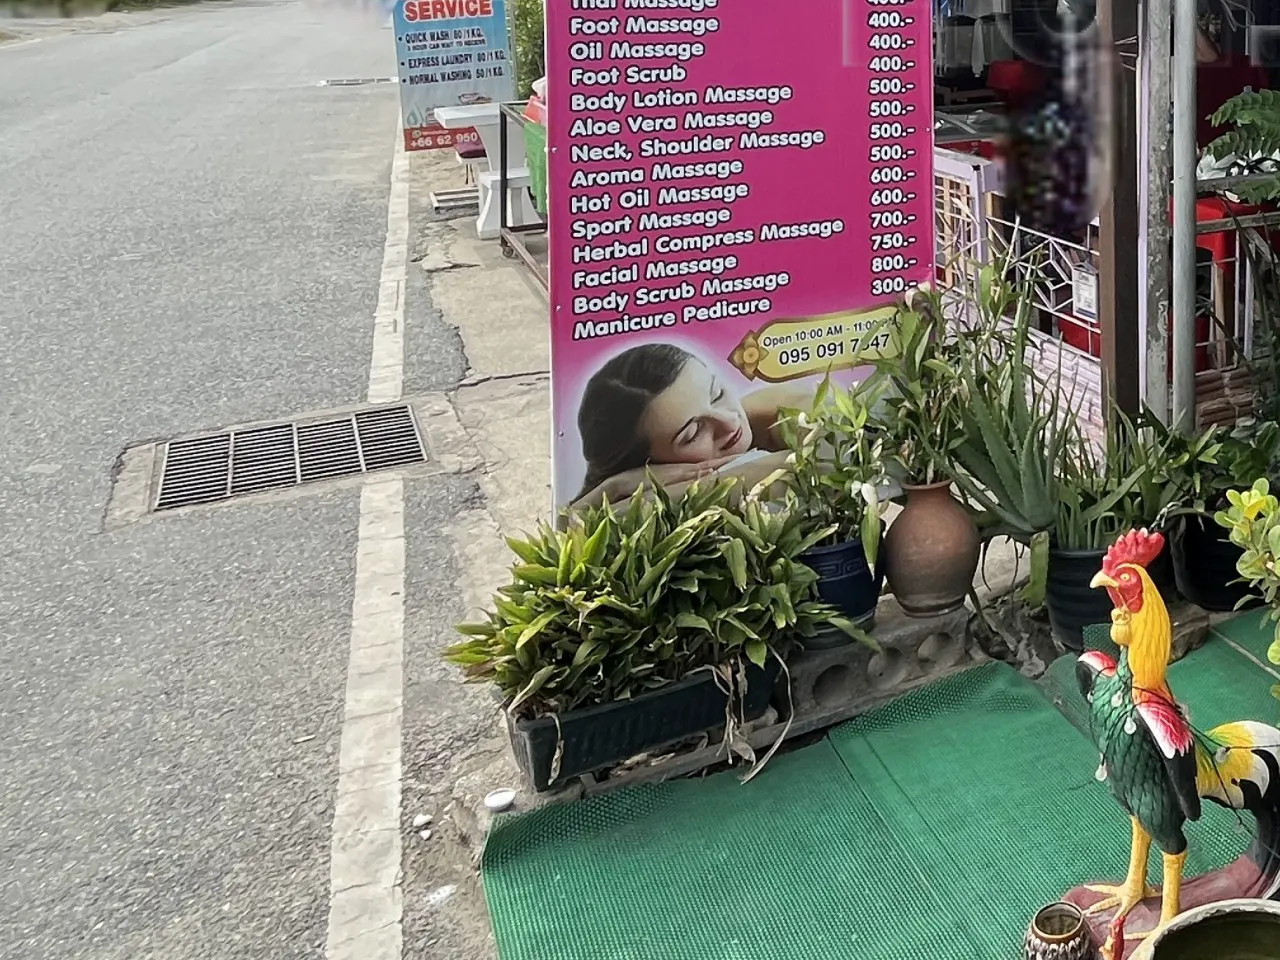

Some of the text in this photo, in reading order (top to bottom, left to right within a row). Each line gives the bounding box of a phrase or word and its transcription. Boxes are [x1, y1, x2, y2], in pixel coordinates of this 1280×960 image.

[404, 0, 493, 21] SERVICE
[571, 12, 913, 36] Foot Massage 400.-
[405, 31, 427, 44] QUICK
[430, 29, 450, 42] WASH
[570, 34, 914, 60] Oil Massage 400.-
[409, 56, 439, 69] EXPRESS
[442, 53, 472, 65] LAUNDRY
[409, 72, 439, 85] NORMAL
[441, 69, 472, 82] WASHING
[571, 56, 914, 86] Foot Scrub 400.-
[571, 78, 914, 113] Body Lotion Massage 500.-
[570, 100, 914, 136] Aloe Vera Massage 500.-
[410, 136, 432, 148] +66
[436, 135, 452, 145] 62
[456, 132, 478, 142] 950
[571, 122, 915, 162] Neck, Shoulder Massage 500.-
[571, 144, 915, 187] Aroma Massage 500.-
[571, 166, 915, 213] Hot Oil Massage 600.-
[572, 188, 915, 240] Sport Massage 600.-
[573, 210, 916, 263] Herbal Compress Massage 700.-
[574, 232, 916, 289] Facial Massage 750.-
[574, 254, 917, 314] Body Scrub Massage 800.-
[574, 277, 918, 339] Manicure Pedicure 300.-
[763, 335, 792, 348] Open
[795, 328, 823, 340] 10:00
[826, 325, 843, 336] AM
[779, 334, 890, 365] 095 091 747
